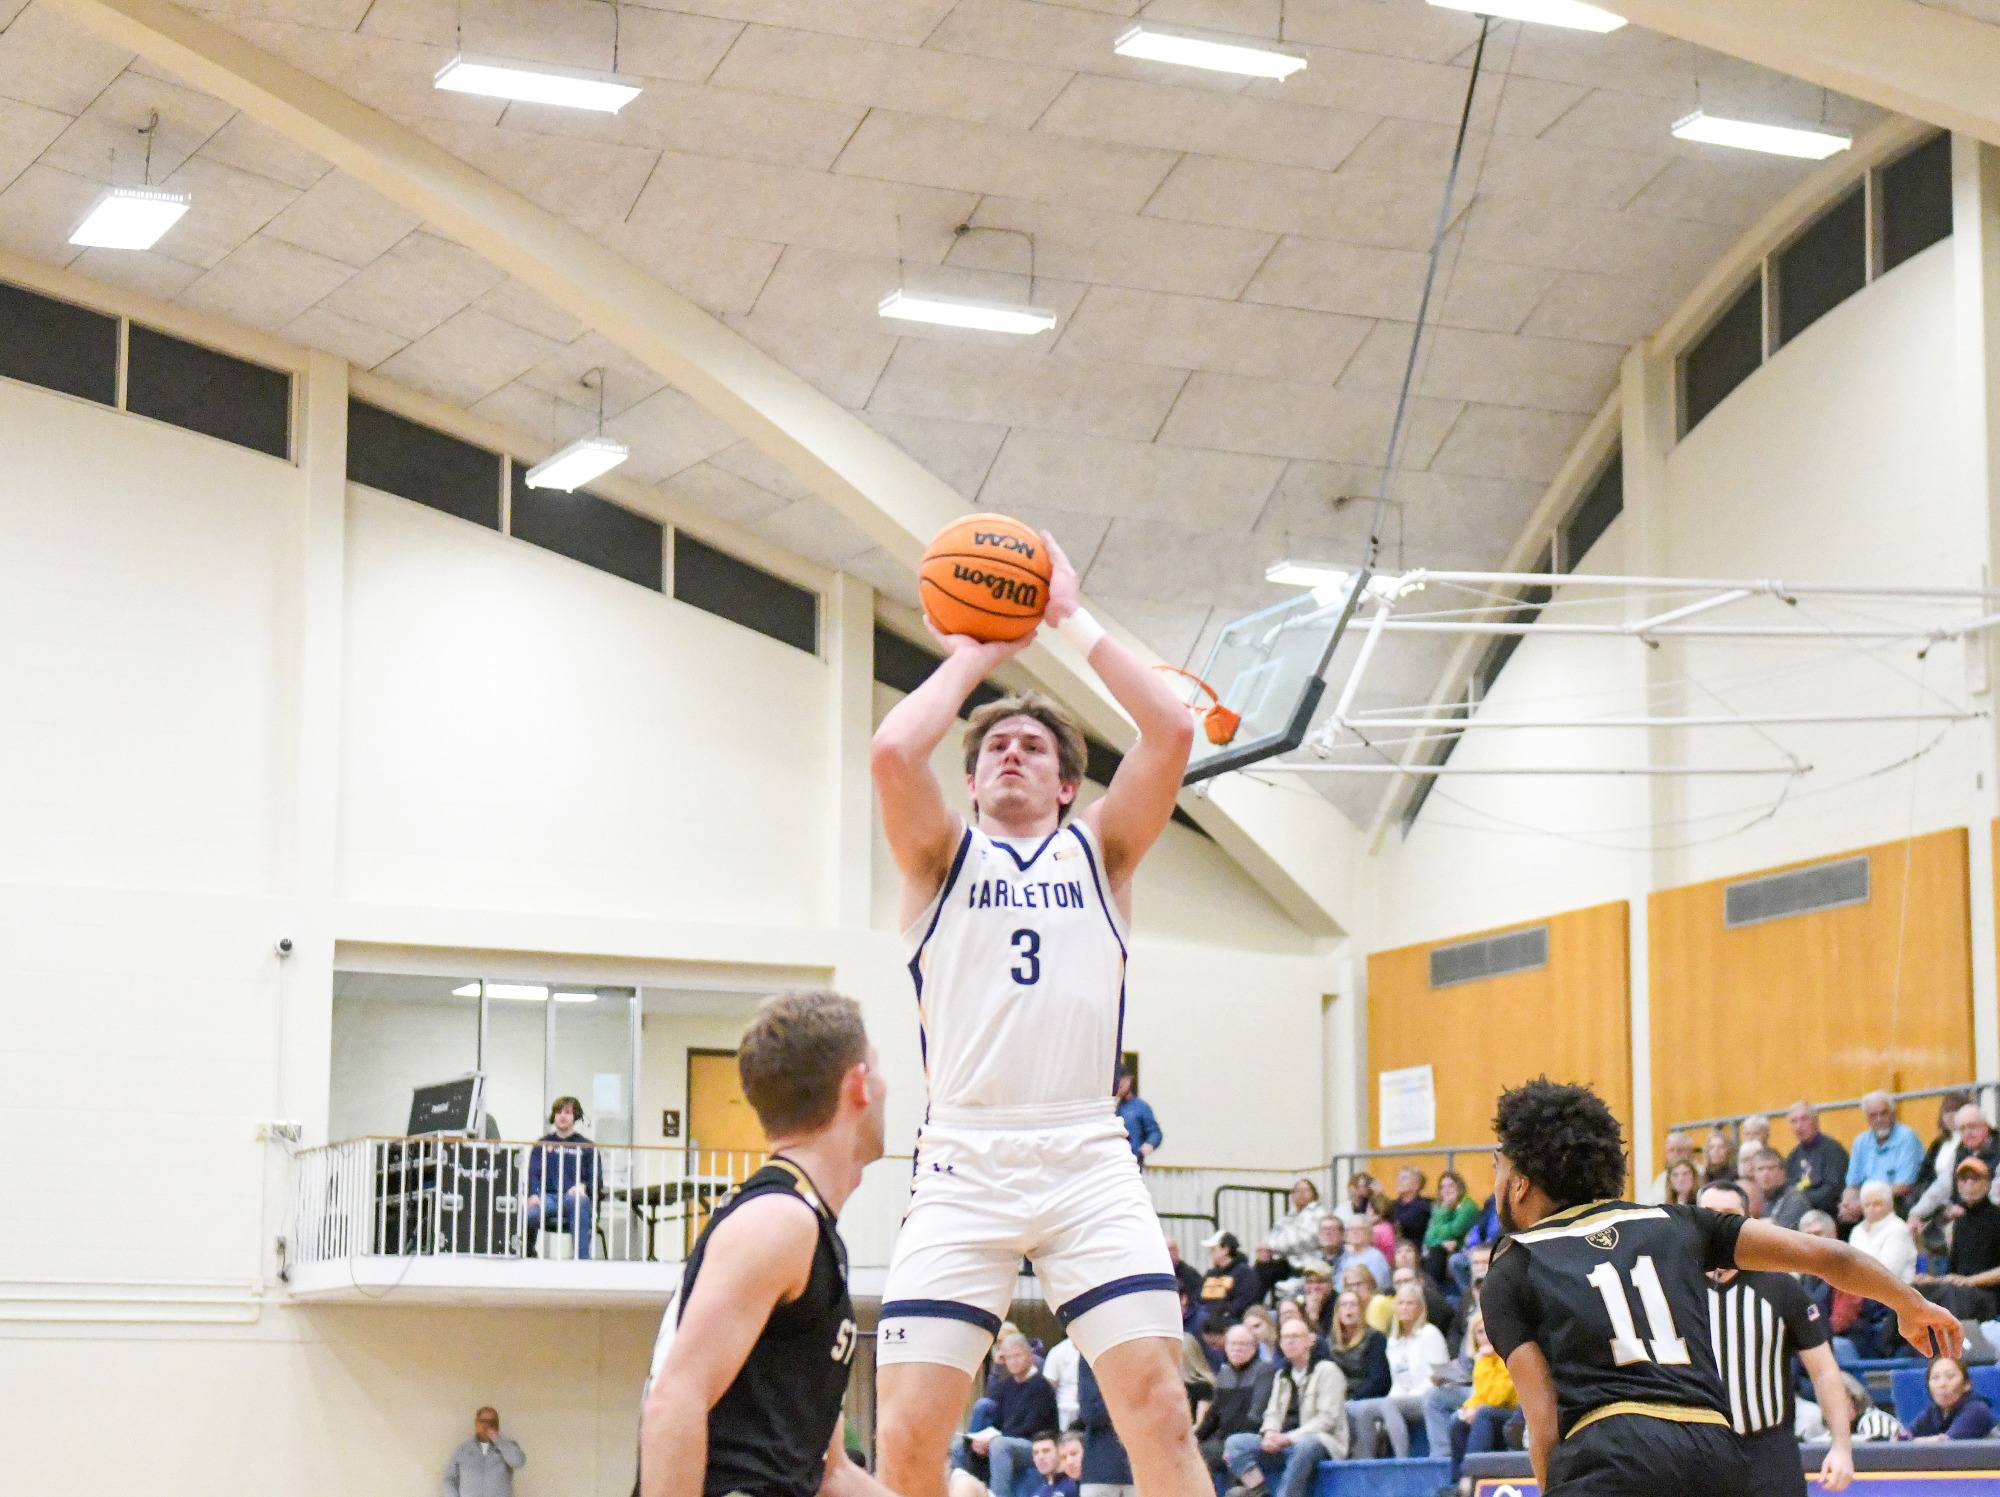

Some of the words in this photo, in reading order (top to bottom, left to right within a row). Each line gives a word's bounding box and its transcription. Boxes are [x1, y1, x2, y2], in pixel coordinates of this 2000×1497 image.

[974, 532, 1035, 560] NCAA
[953, 562, 1038, 609] Wilson
[1011, 928, 1040, 985] 3
[1586, 1255, 1692, 1367] 11
